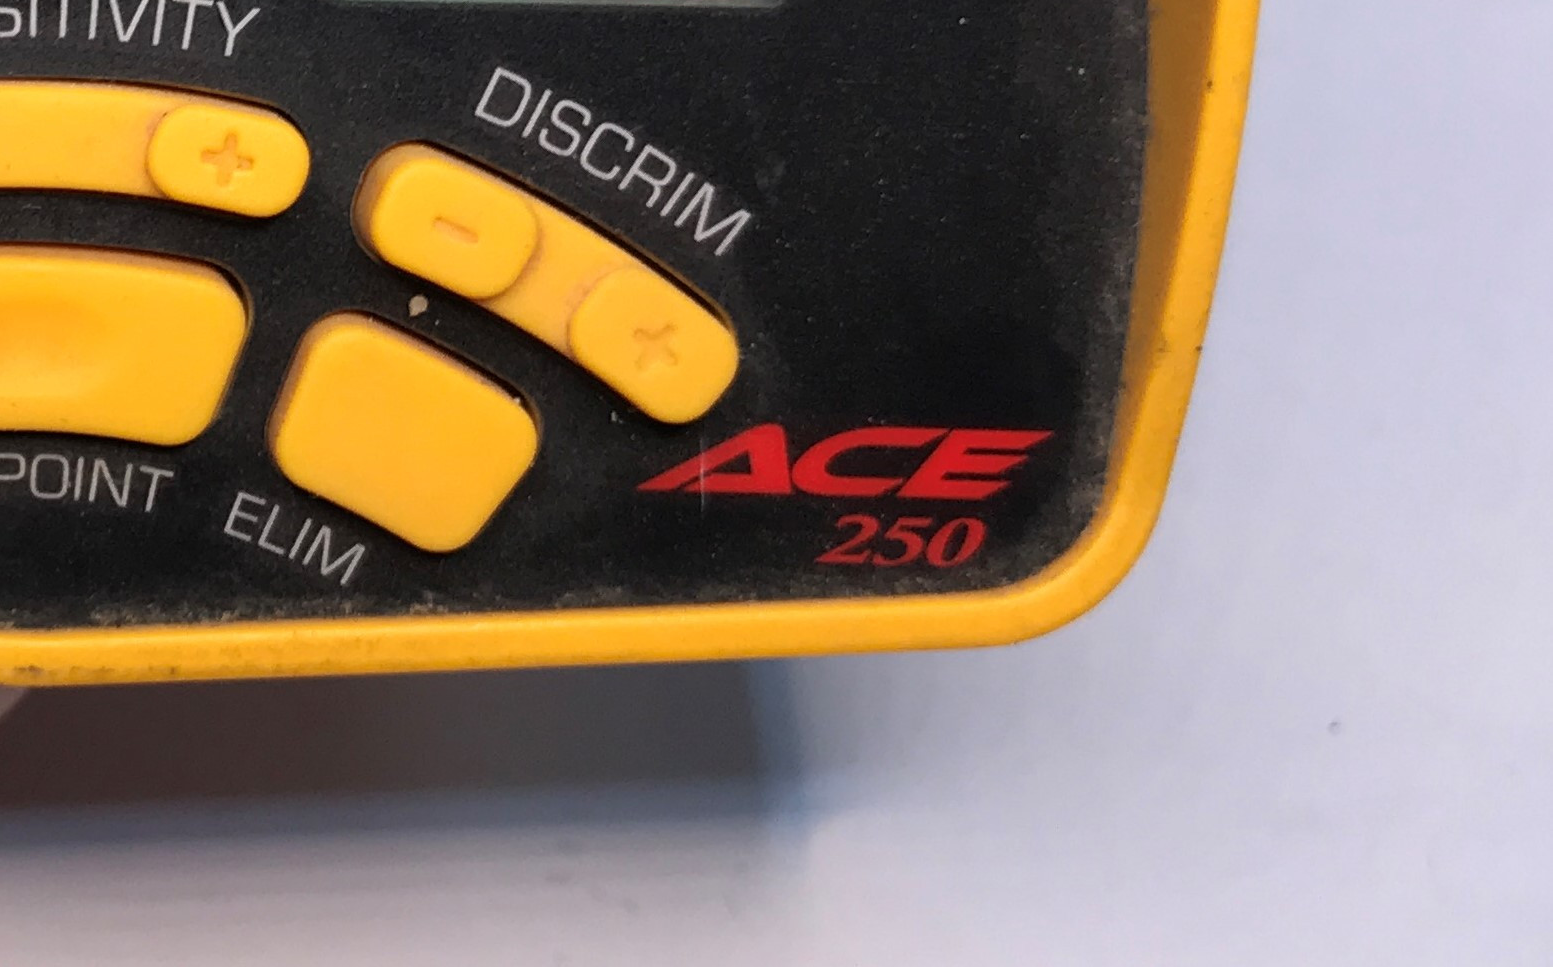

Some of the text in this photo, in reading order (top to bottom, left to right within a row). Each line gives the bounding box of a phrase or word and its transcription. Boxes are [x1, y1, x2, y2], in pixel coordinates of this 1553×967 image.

[473, 66, 752, 257] DISCRIM
[635, 423, 1055, 501] ACE
[222, 491, 368, 587] ELIM
[815, 515, 988, 568] 250
